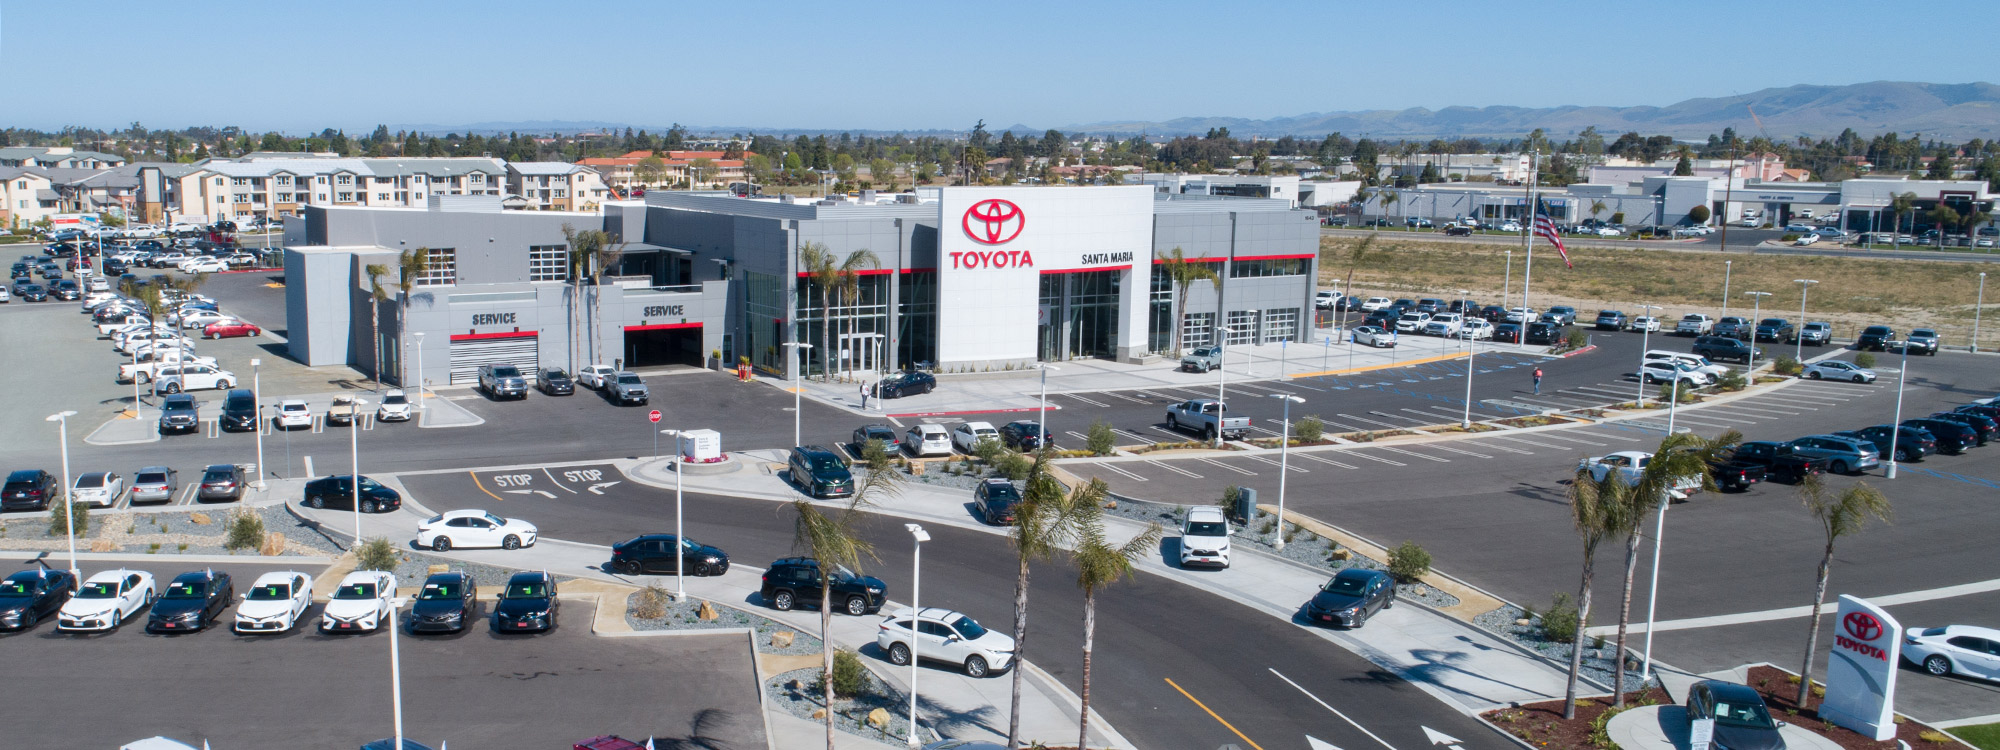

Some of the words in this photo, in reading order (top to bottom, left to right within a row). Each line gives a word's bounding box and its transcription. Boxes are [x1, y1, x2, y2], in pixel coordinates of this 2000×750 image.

[949, 250, 1034, 269] TOYOTA
[1081, 253, 1109, 265] SANTA
[1110, 251, 1134, 263] MARIA
[643, 305, 684, 317] SERVICE
[472, 312, 517, 326] SERVICE
[494, 474, 533, 487] STOP
[564, 469, 603, 482] STOP
[1835, 635, 1887, 662] TOYOTA
